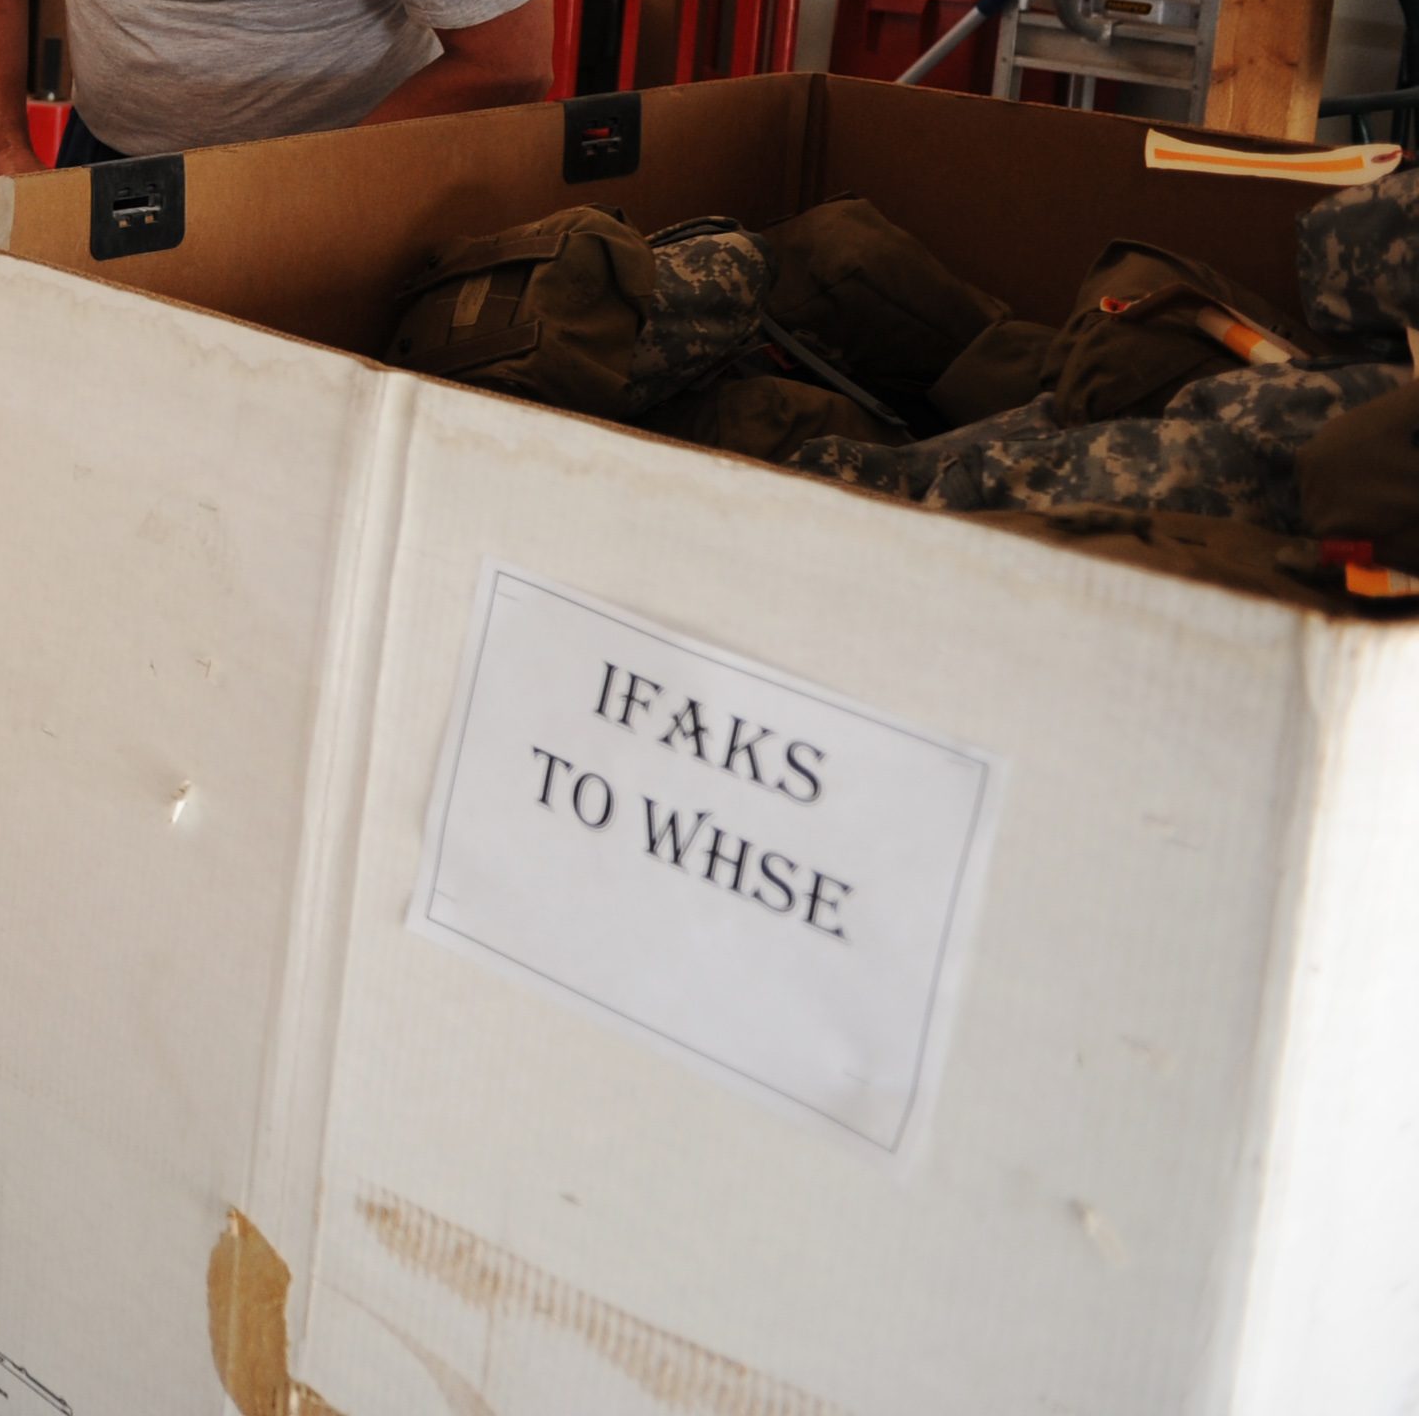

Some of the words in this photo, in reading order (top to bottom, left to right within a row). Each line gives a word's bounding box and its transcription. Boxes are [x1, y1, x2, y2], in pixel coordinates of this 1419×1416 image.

[592, 660, 831, 805] IFAKS
[530, 745, 618, 831] TO
[641, 795, 855, 942] WHSE
